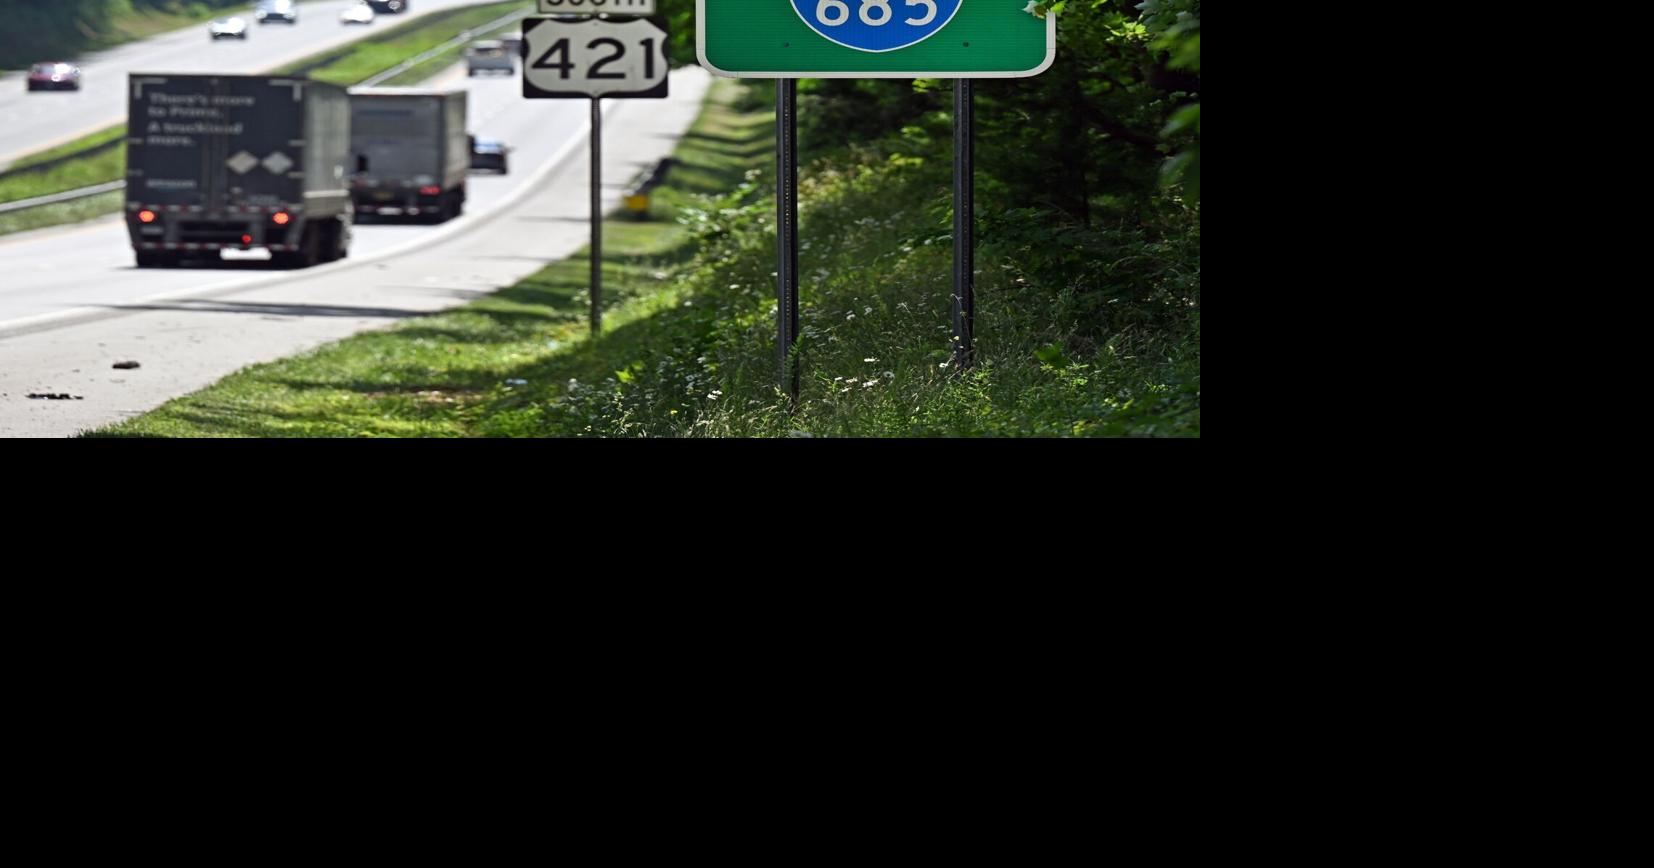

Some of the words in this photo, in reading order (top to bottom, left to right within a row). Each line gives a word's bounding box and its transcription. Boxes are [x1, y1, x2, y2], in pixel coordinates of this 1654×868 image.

[816, 0, 937, 26] 685
[531, 37, 655, 79] 421
[148, 92, 207, 104] There's
